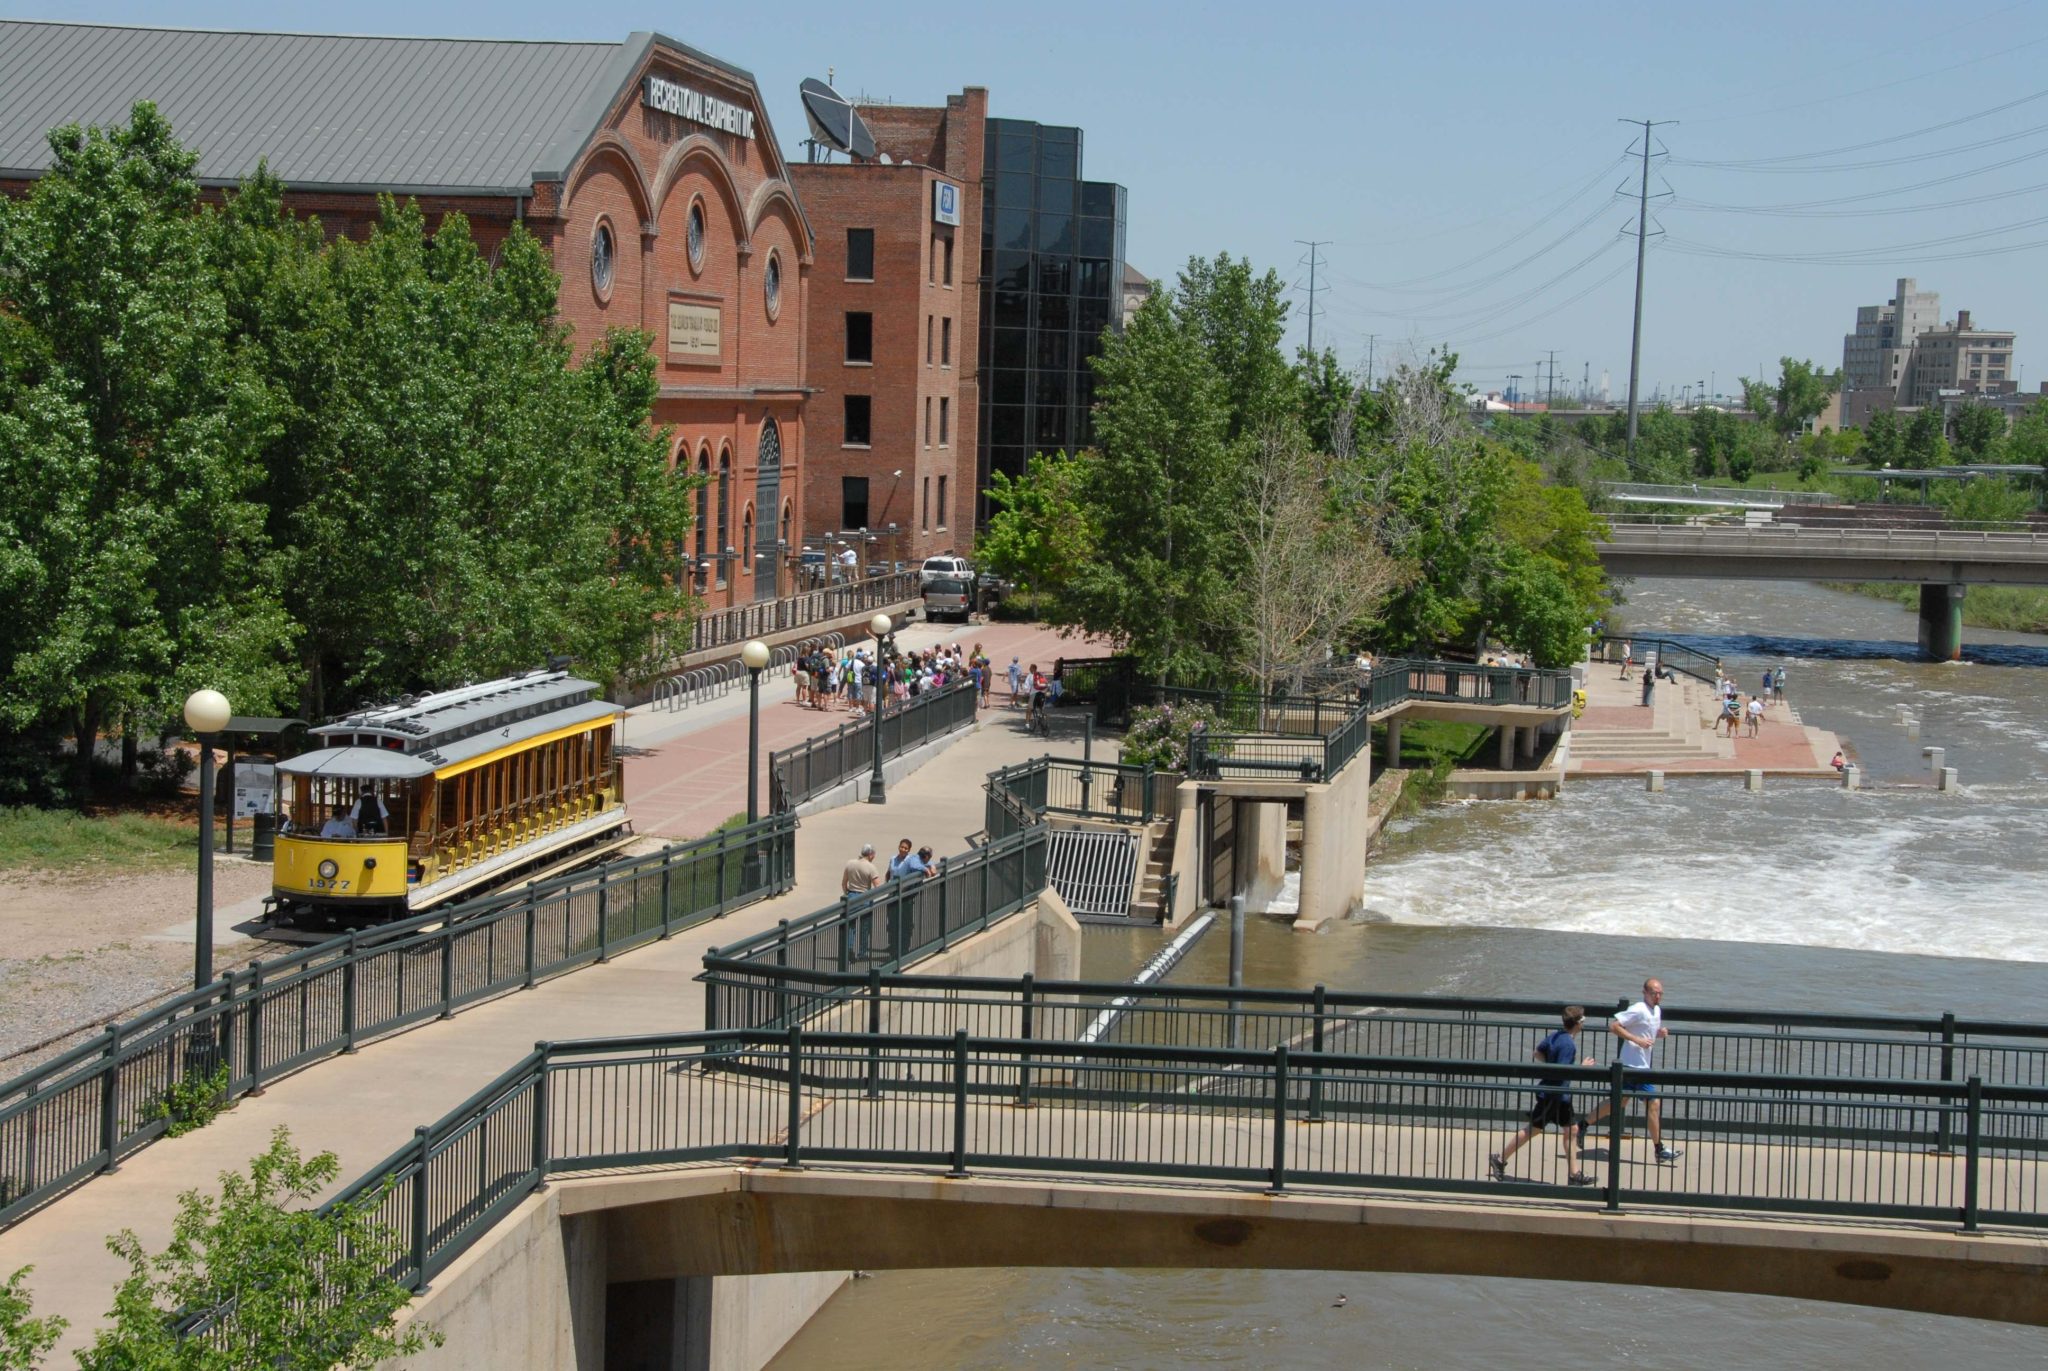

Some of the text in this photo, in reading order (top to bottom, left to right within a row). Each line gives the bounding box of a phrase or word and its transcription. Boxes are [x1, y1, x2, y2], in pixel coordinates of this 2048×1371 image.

[650, 77, 704, 123] RECREATIONAL
[705, 97, 742, 135] EQUIPMENT
[308, 878, 350, 889] 1977
